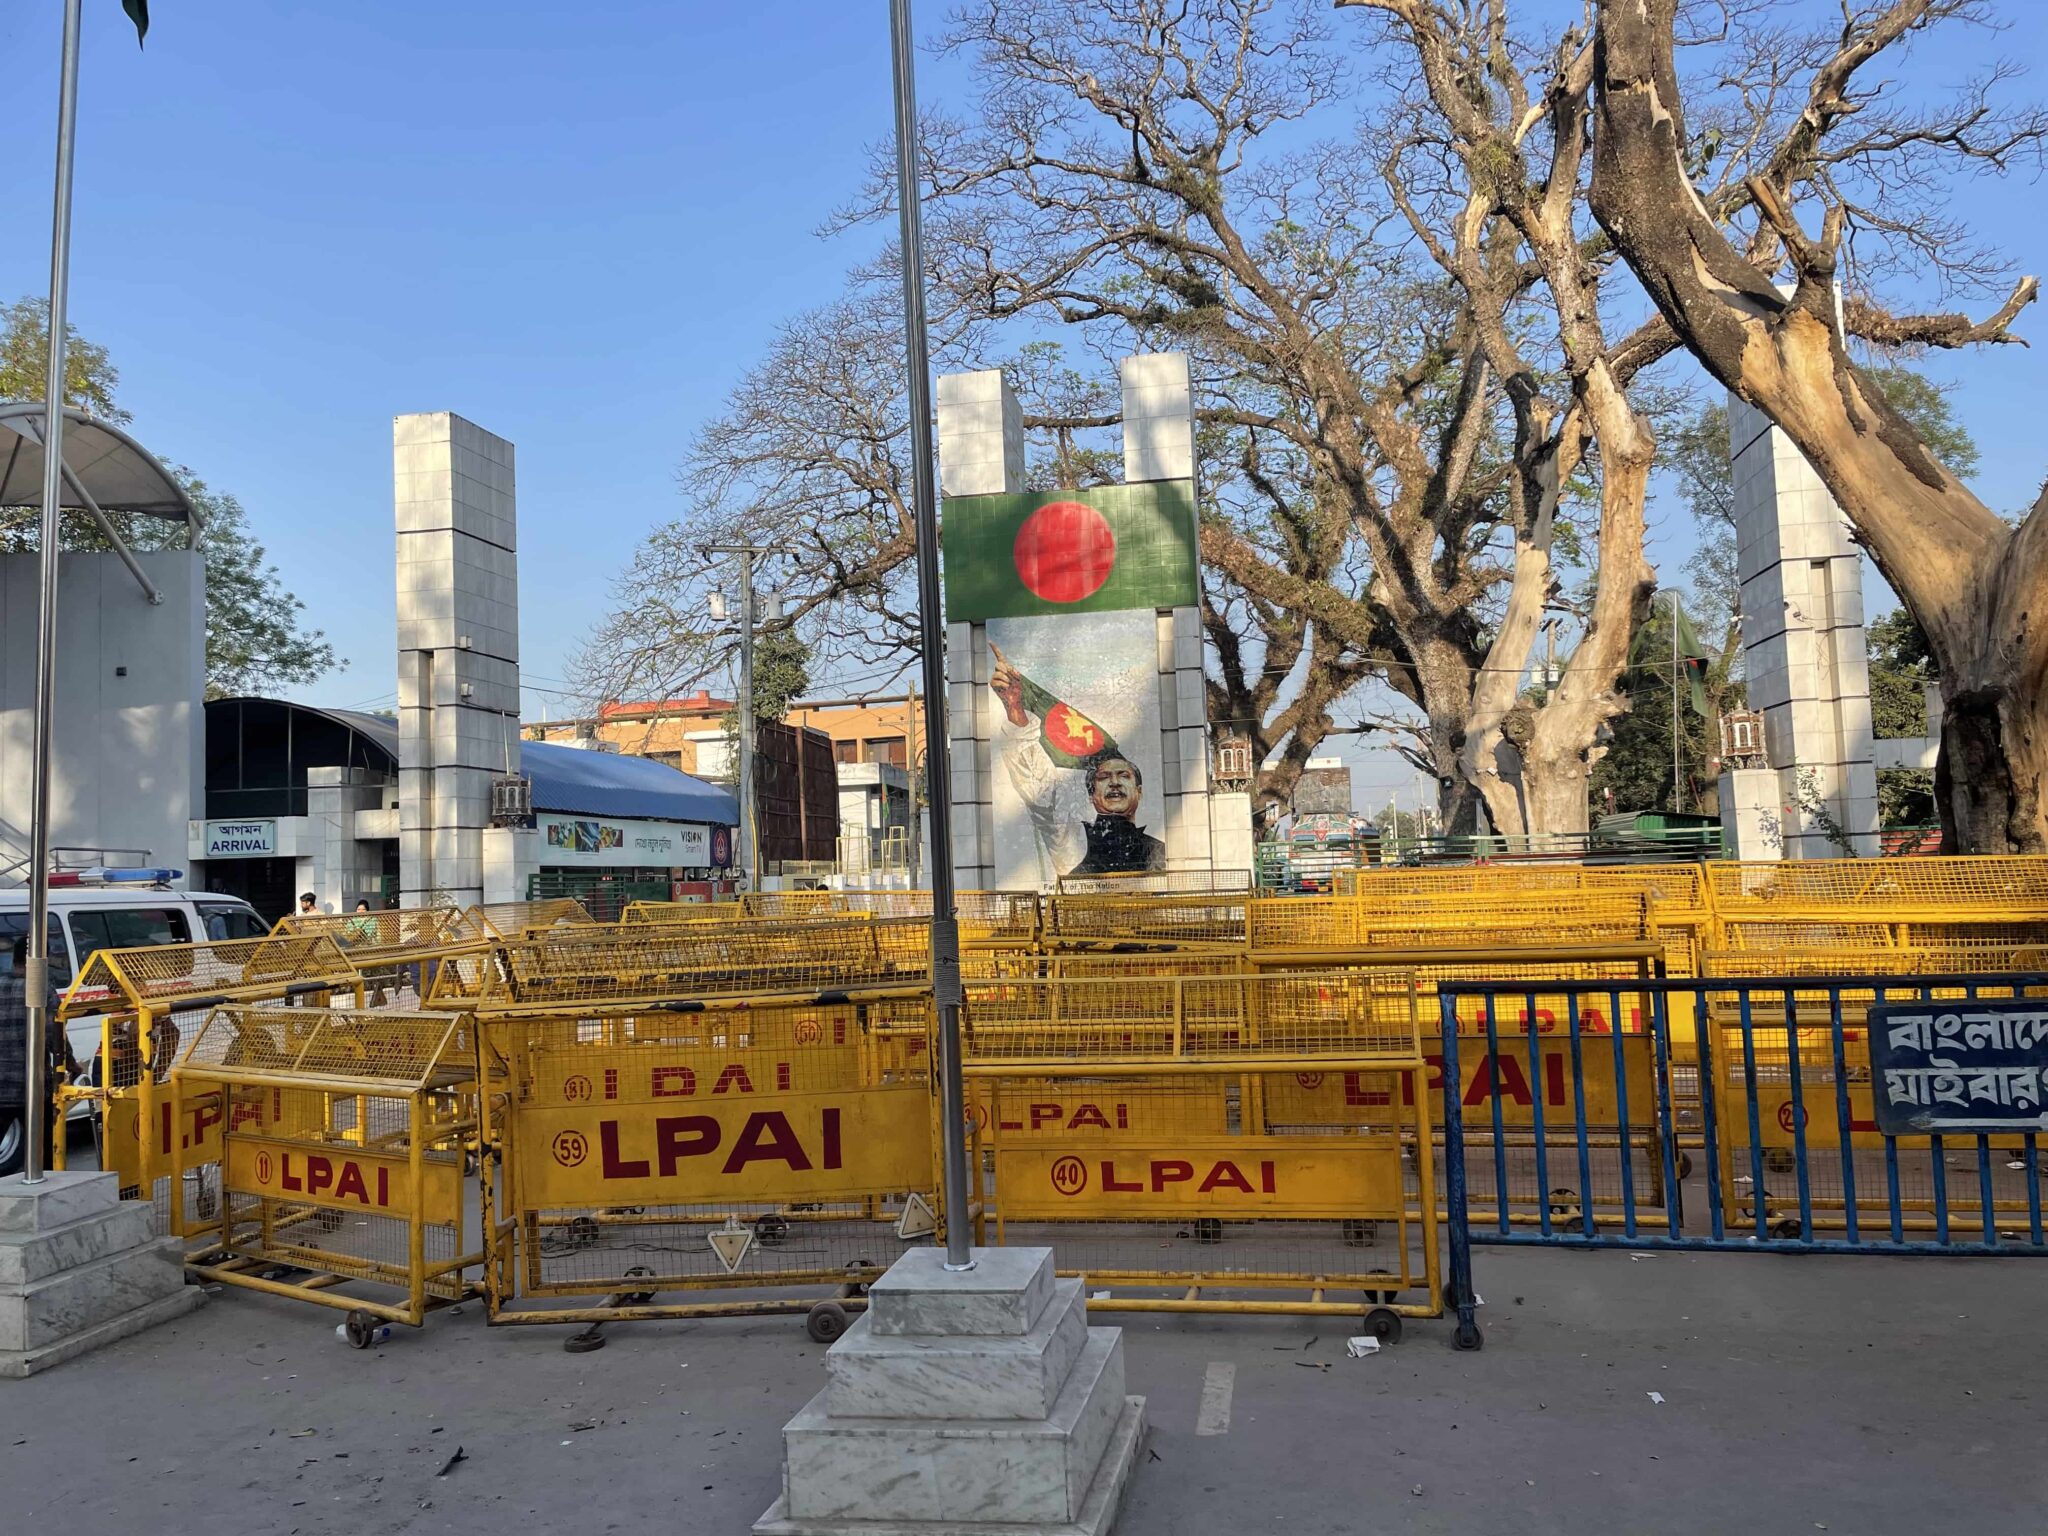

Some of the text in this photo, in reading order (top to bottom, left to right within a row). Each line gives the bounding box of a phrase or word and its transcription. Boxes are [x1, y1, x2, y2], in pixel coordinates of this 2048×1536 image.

[218, 825, 262, 836] আগমন
[680, 830, 703, 843] VISION
[210, 839, 270, 852] ARRIVAL
[1095, 881, 1120, 889] Nation
[1883, 1053, 2040, 1110] যাইবার
[990, 1103, 1128, 1130] LPAI
[559, 1108, 842, 1179] 59 LPAI
[281, 1152, 389, 1207] LPAI
[1056, 1160, 1276, 1193] 40 LPAI
